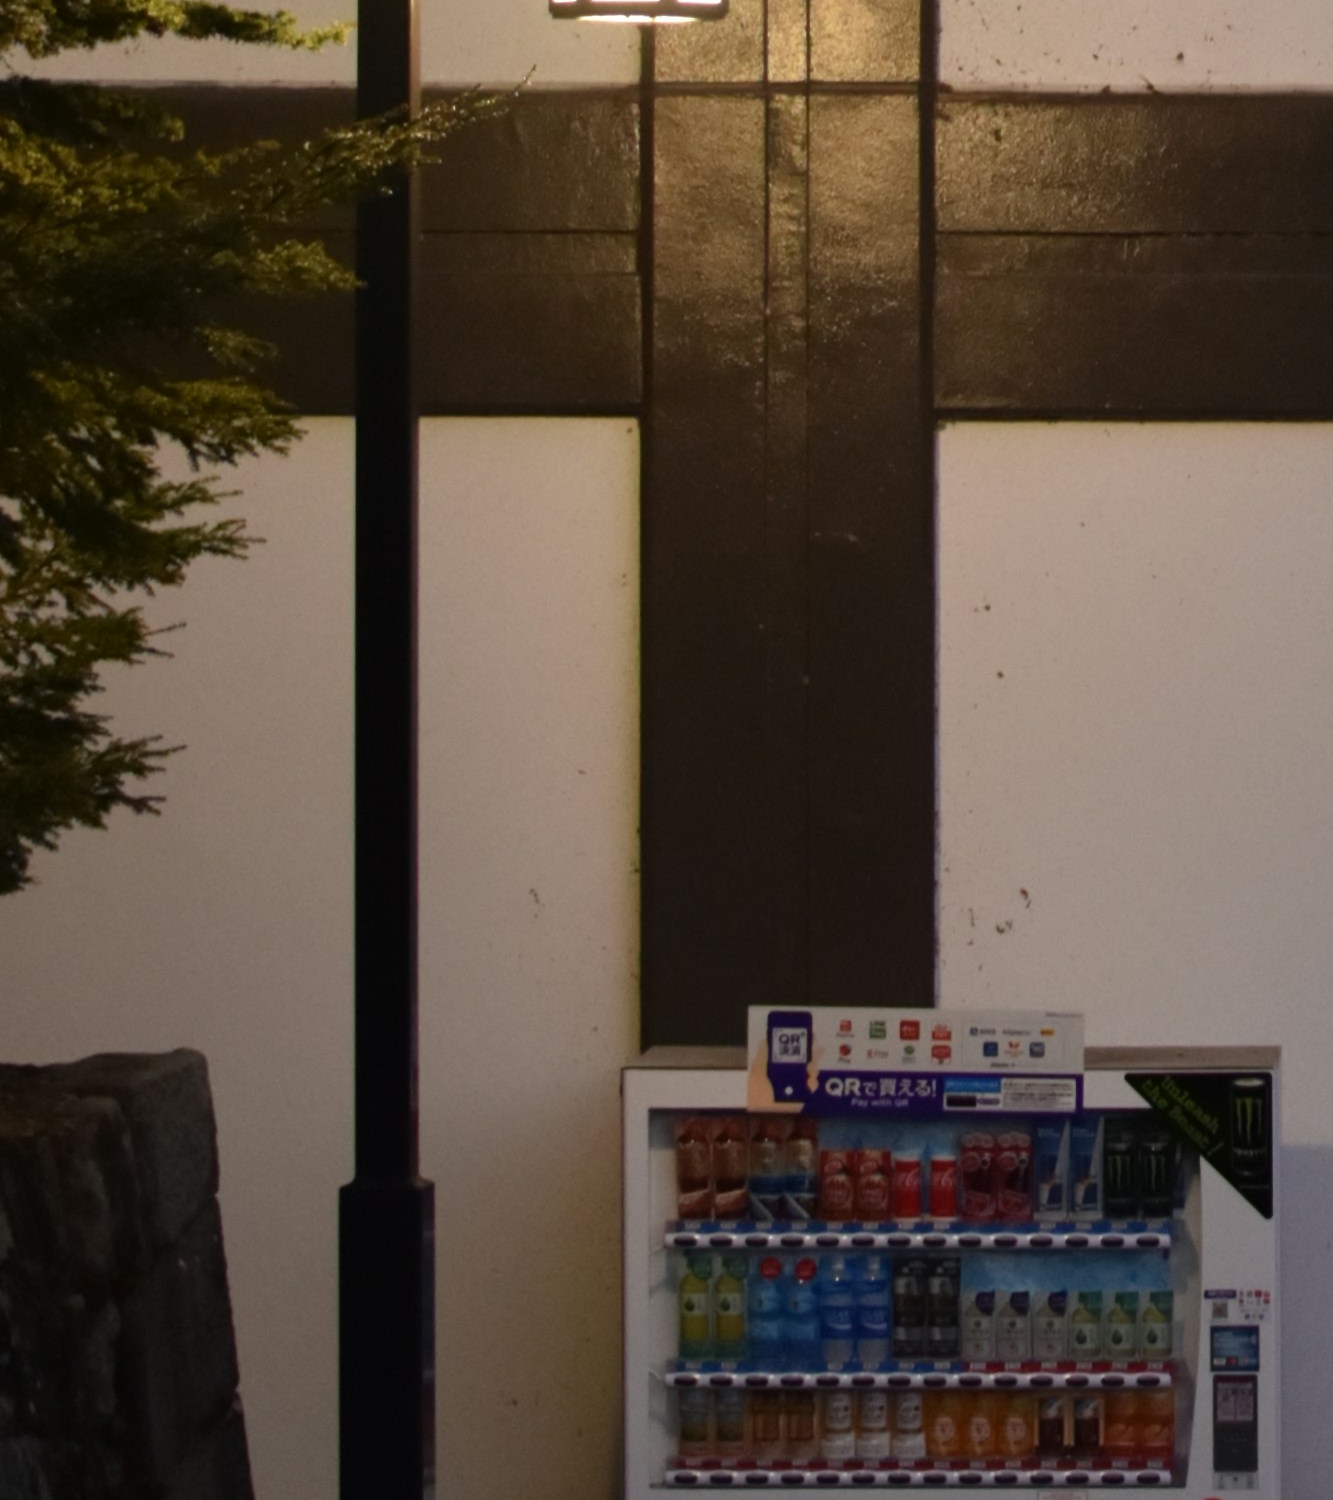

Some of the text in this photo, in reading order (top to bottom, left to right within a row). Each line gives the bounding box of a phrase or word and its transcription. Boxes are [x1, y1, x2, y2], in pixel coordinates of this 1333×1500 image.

[778, 1033, 801, 1045] QR
[825, 1077, 936, 1097] QRで買える!
[851, 1098, 909, 1108] Pay with QR
